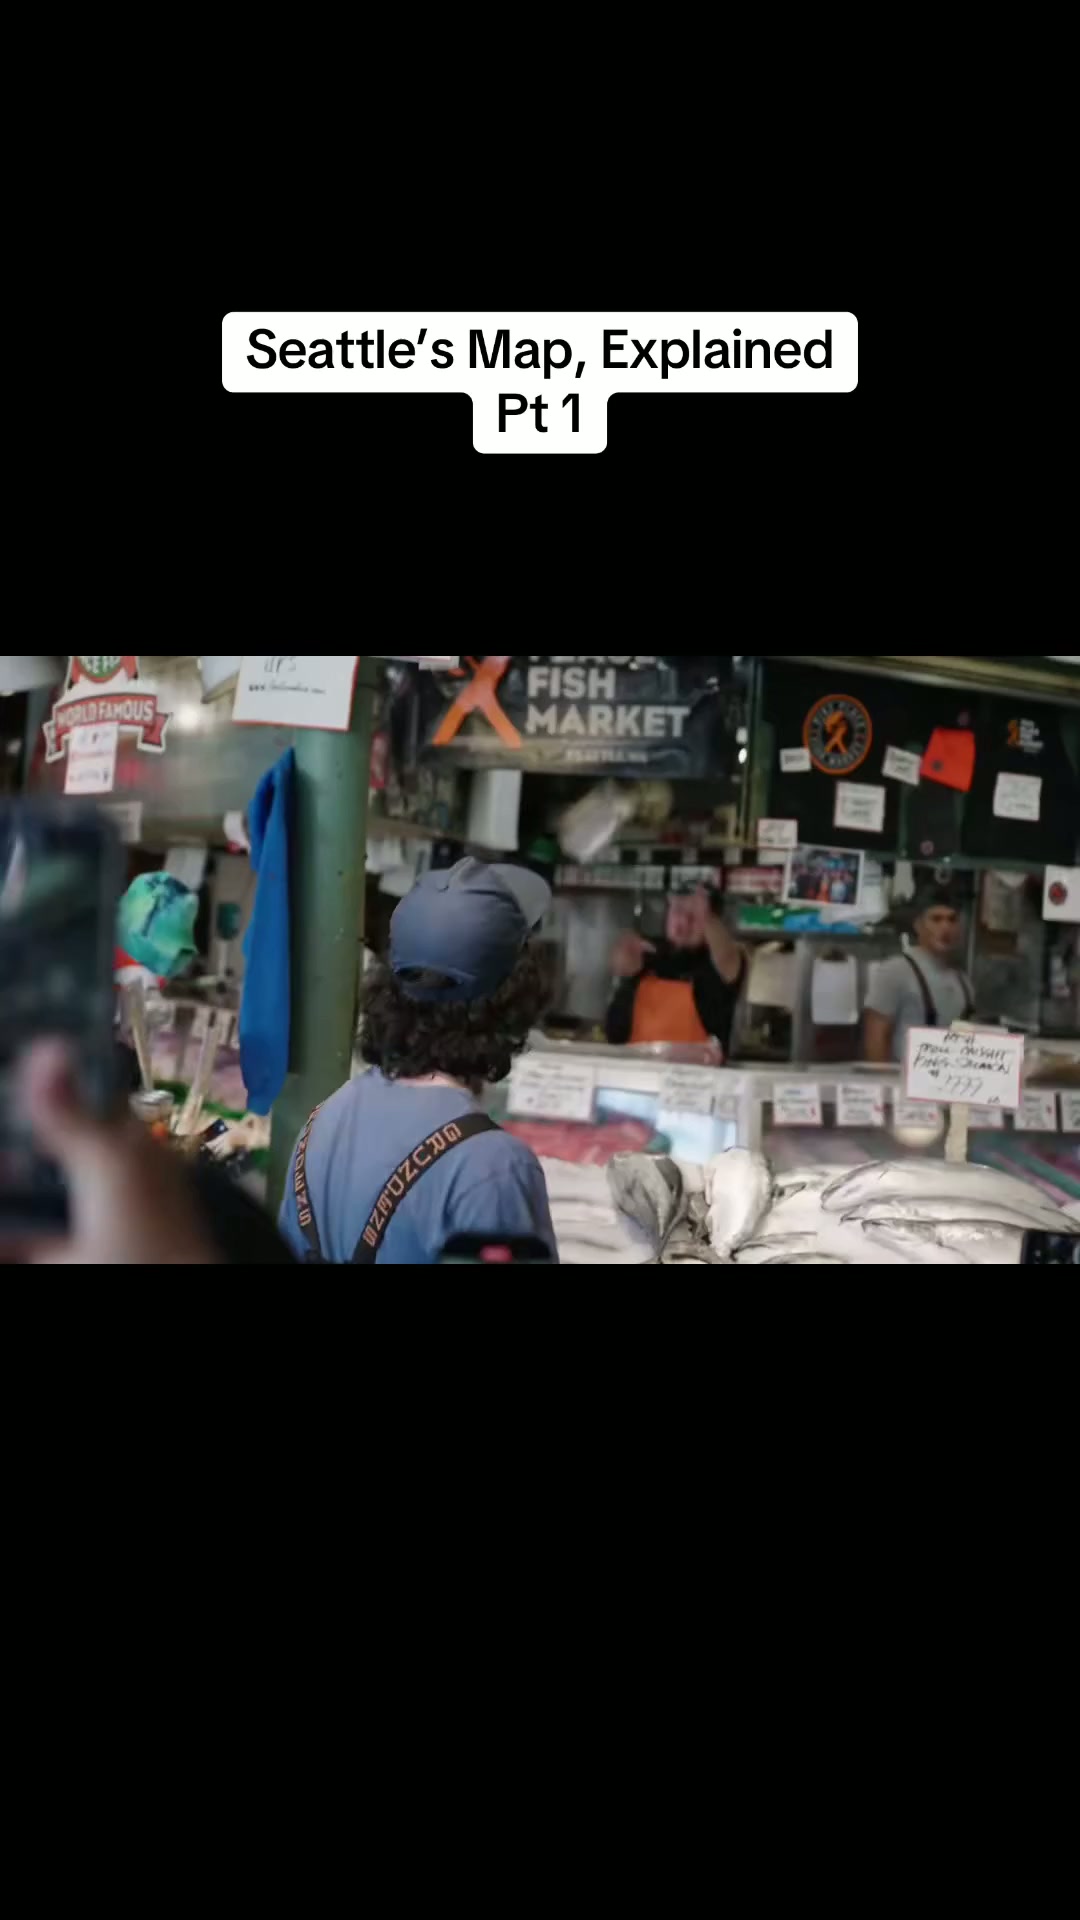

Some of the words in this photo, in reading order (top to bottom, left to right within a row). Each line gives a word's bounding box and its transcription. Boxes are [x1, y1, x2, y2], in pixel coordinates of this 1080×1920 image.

[528, 666, 617, 699] FISH
[57, 703, 98, 729] WORLD
[99, 699, 153, 724] FAMOUS
[525, 704, 690, 738] MARKET
